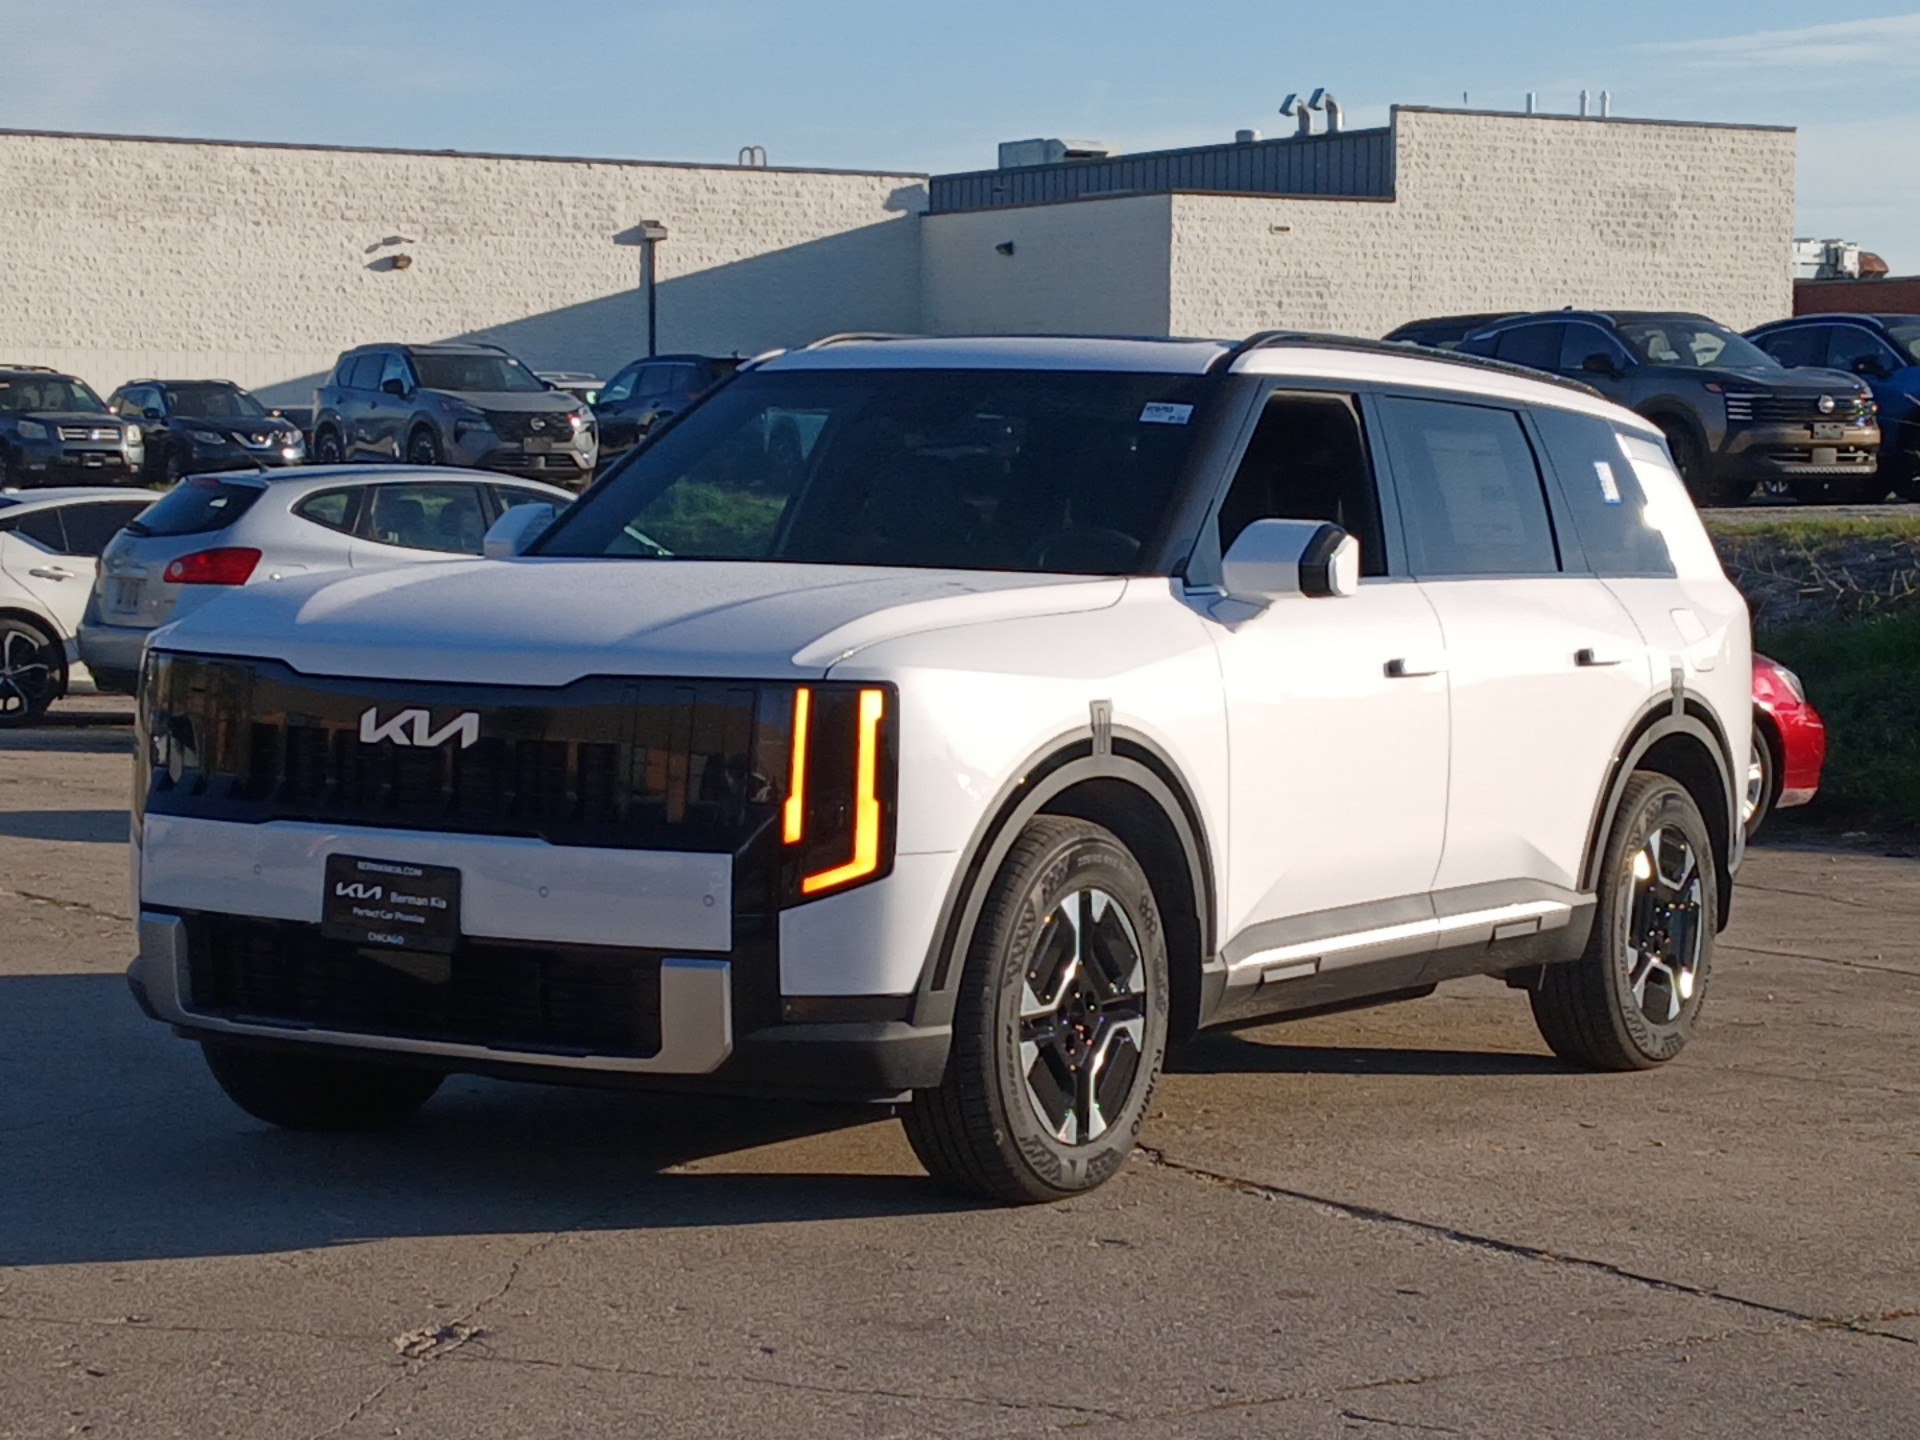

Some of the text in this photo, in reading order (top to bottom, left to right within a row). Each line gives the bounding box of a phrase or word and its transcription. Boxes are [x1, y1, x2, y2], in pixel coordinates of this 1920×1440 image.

[360, 706, 479, 748] KIA
[336, 882, 382, 899] KIA
[390, 892, 447, 909] Berman Kia
[367, 931, 404, 944] CHICAGO
[1131, 1049, 1162, 1136] KUMHO
